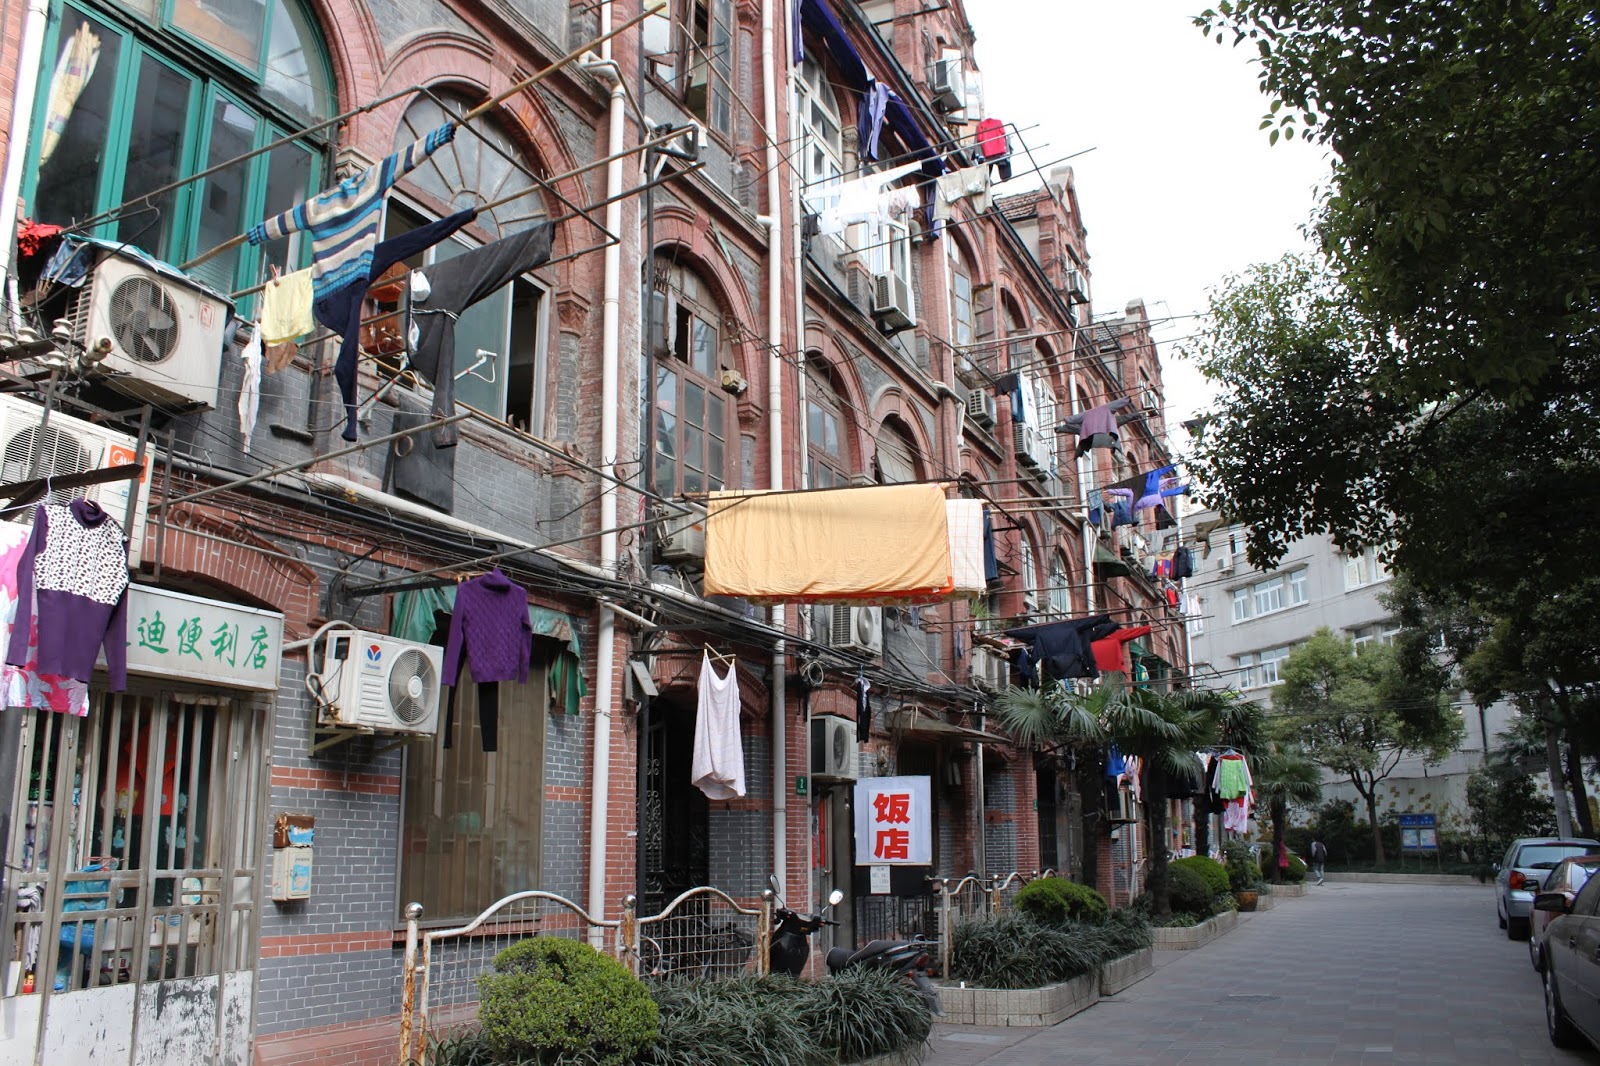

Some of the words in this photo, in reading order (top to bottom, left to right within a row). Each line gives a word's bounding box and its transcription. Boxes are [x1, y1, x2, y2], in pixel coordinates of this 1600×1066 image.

[127, 610, 269, 669] 迪便利店
[873, 793, 911, 859] 饭店
